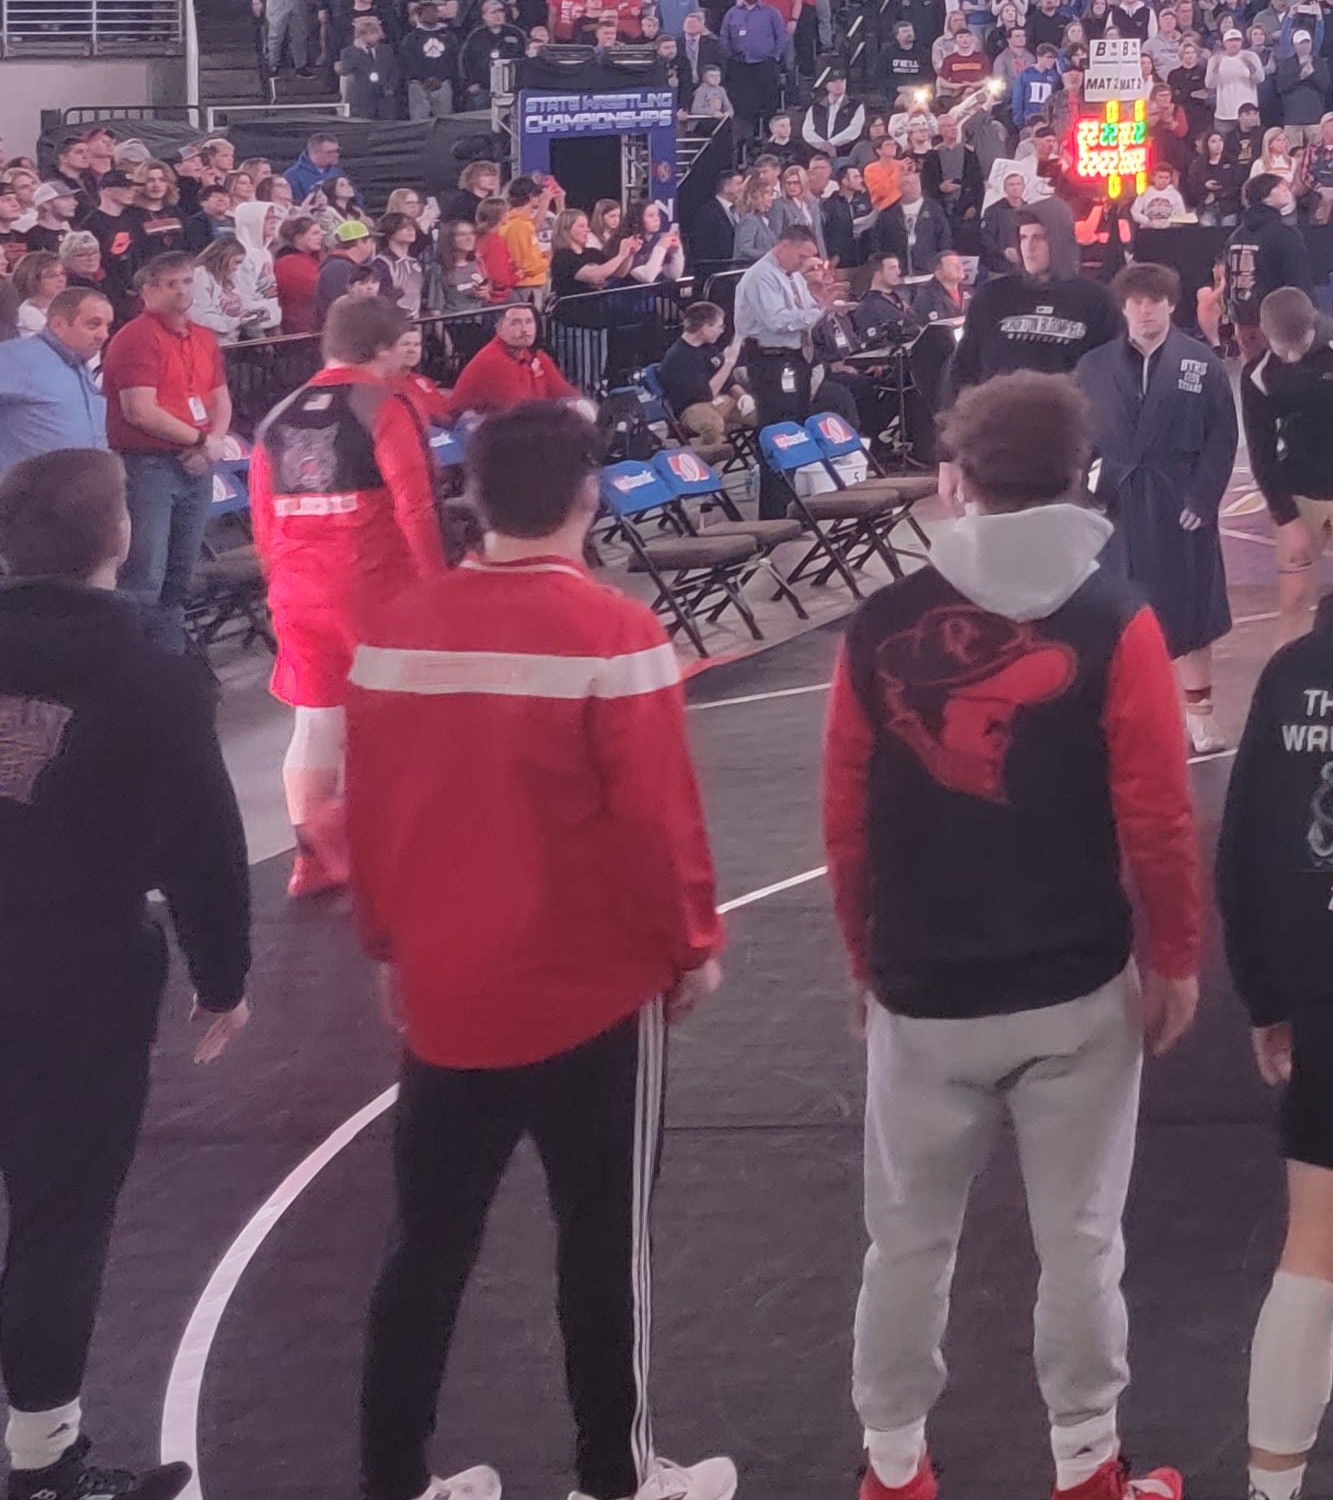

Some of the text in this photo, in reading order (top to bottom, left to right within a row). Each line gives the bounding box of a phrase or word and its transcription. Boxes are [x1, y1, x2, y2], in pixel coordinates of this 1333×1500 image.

[1085, 78, 1112, 91] MAT
[525, 92, 673, 114] STATE WRESTLING
[525, 109, 673, 134] CHAMPIONSHIPS
